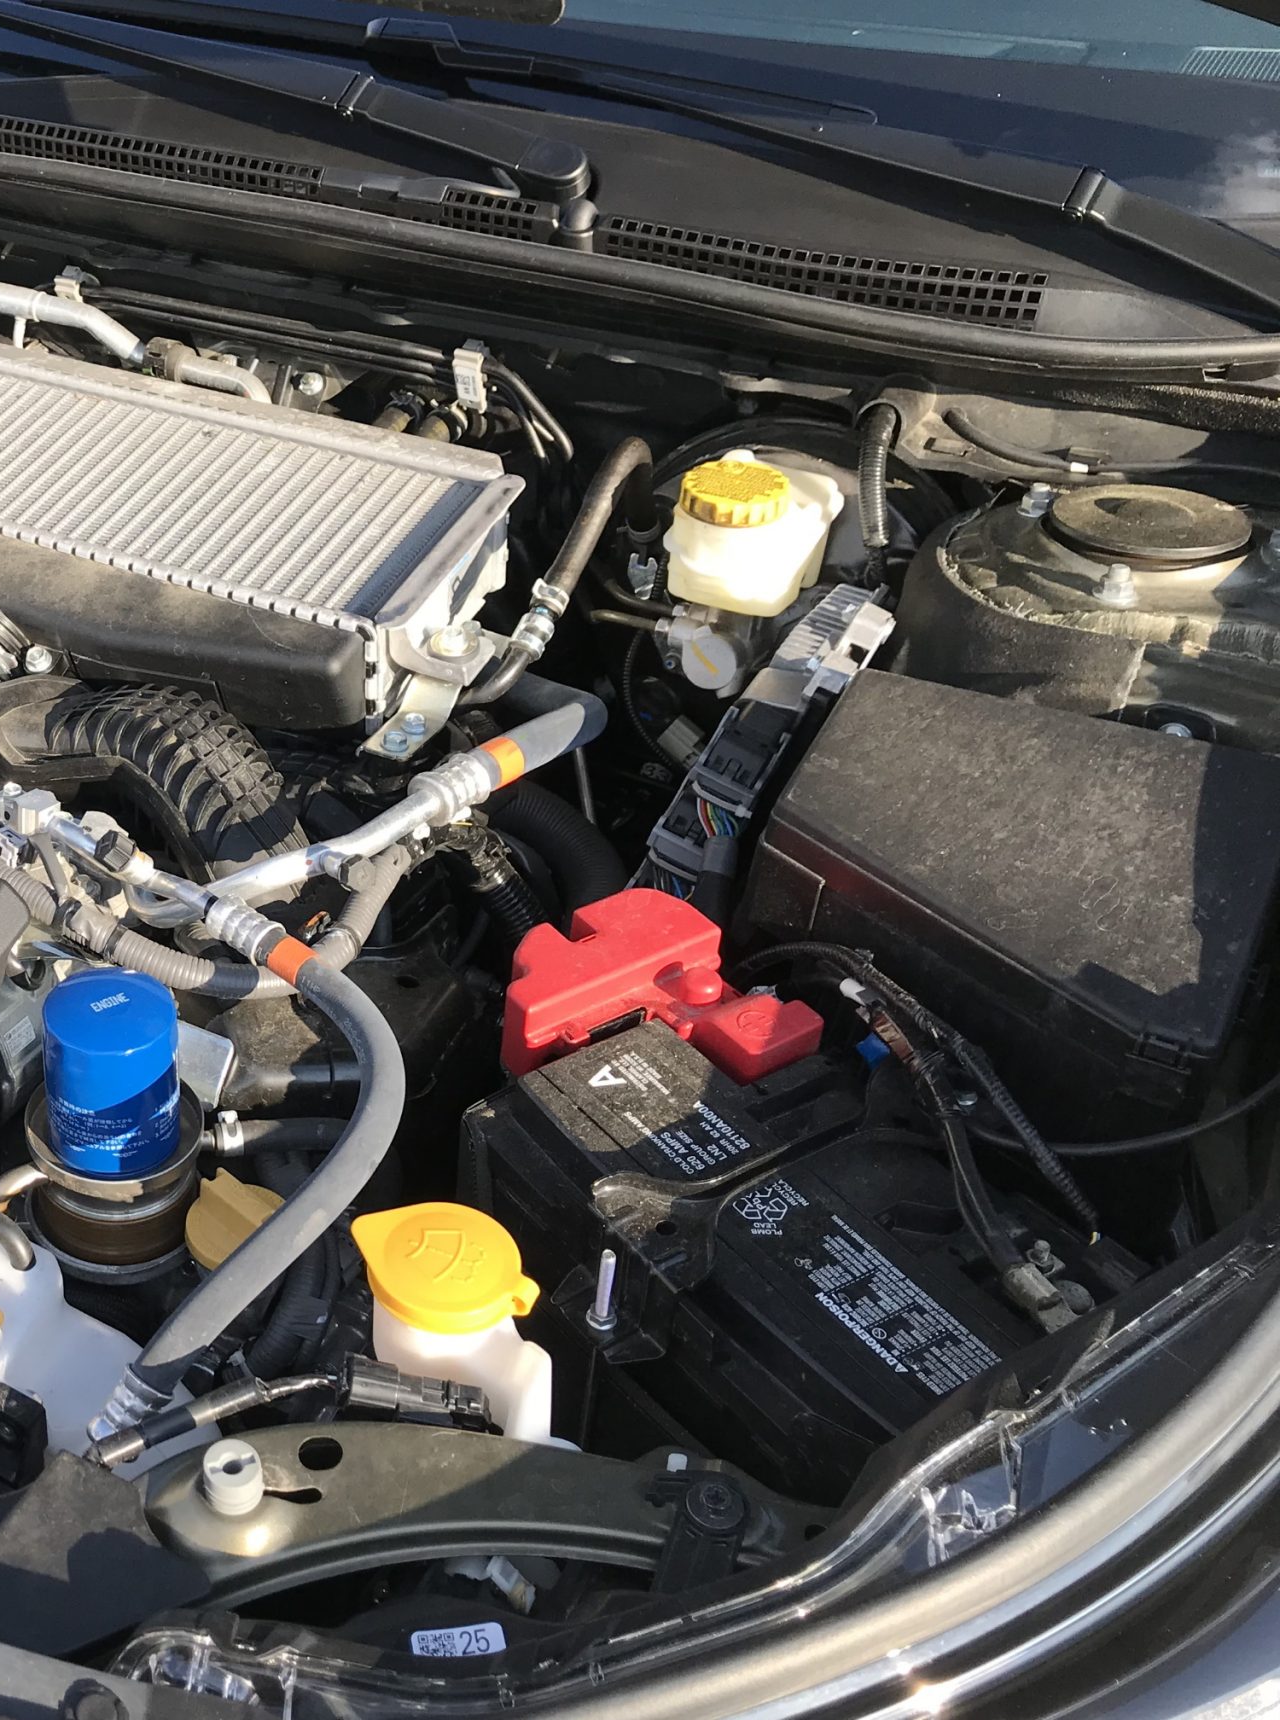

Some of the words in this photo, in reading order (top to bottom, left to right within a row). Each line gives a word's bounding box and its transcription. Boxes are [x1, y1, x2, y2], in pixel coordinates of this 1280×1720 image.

[89, 992, 130, 1013] ENGINE
[622, 1111, 646, 1128] AMPS
[640, 1127, 676, 1158] CRANKING
[659, 1131, 688, 1154] AMPS
[673, 1129, 694, 1144] SIZE
[689, 1142, 716, 1165] GROUP
[705, 1143, 728, 1160] LN2
[672, 1156, 695, 1174] COLD
[686, 1155, 705, 1170] 620
[751, 1228, 783, 1236] PLOMB
[815, 1292, 898, 1366] DANGER/POISON
[459, 1628, 490, 1656] 25
